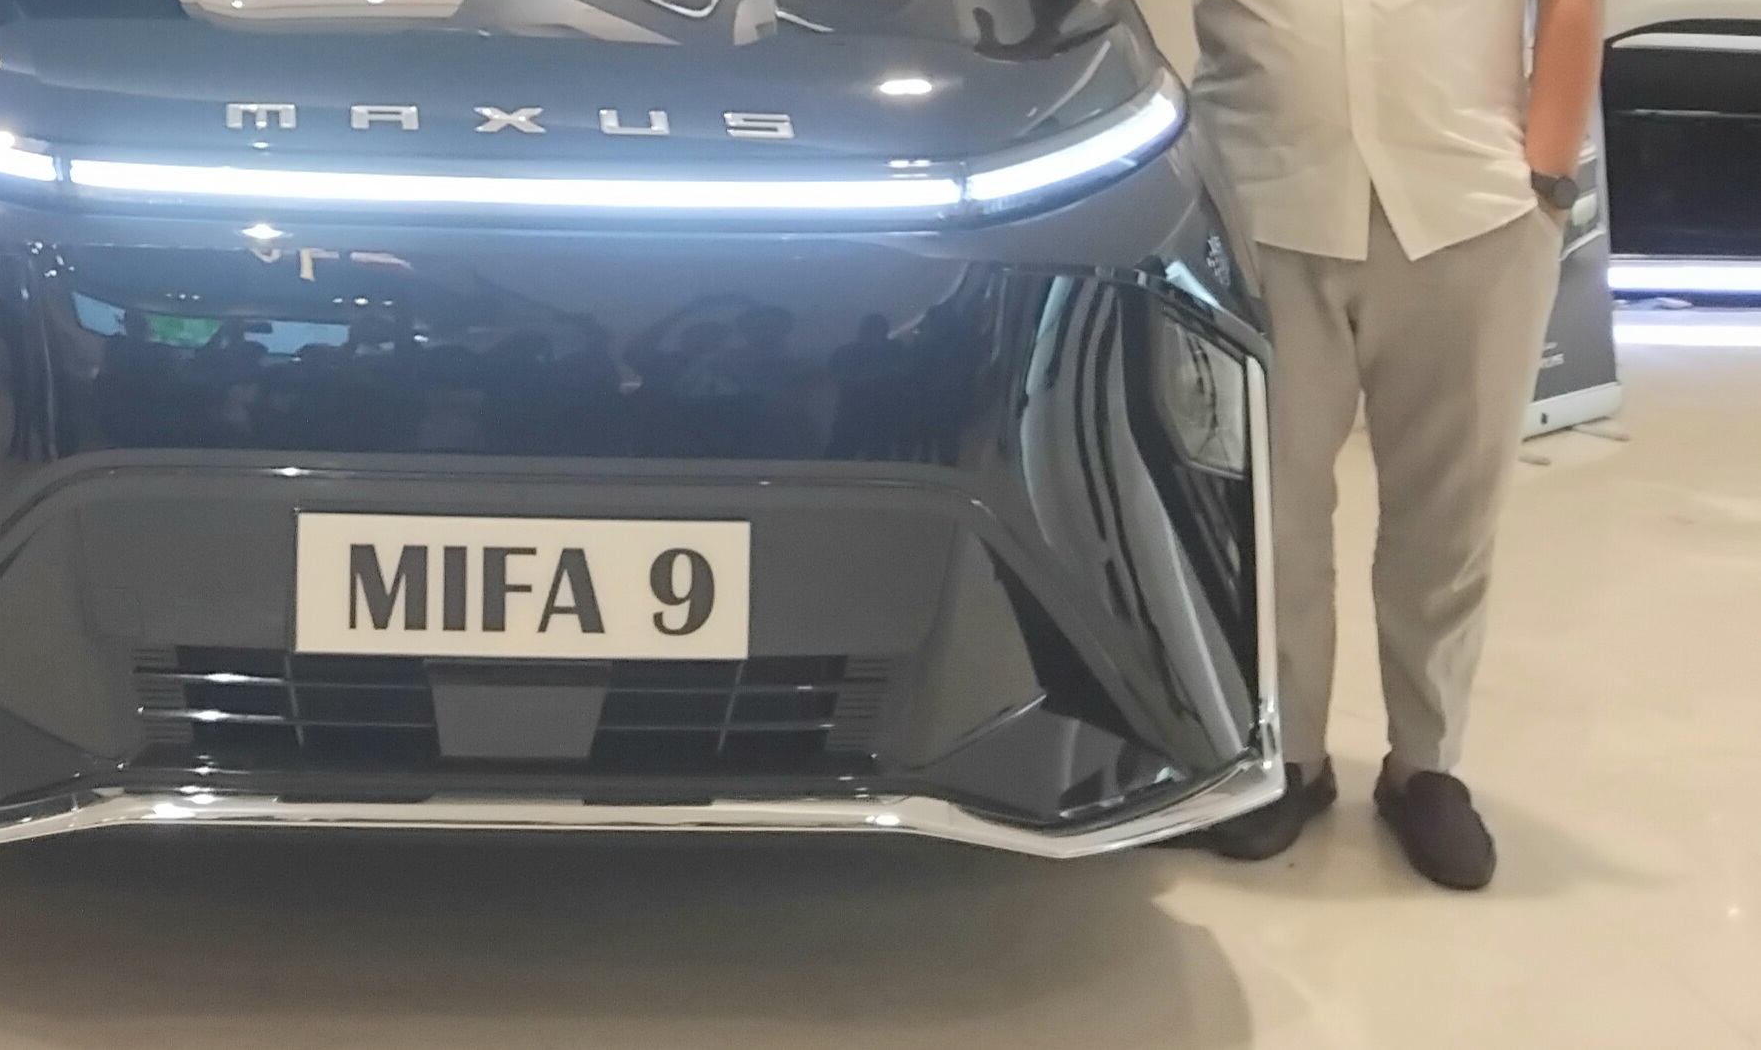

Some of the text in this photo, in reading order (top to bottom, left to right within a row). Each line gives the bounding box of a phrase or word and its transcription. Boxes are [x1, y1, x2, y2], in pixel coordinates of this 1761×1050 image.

[224, 102, 796, 140] MAXUS
[348, 543, 716, 637] MIFA 9
